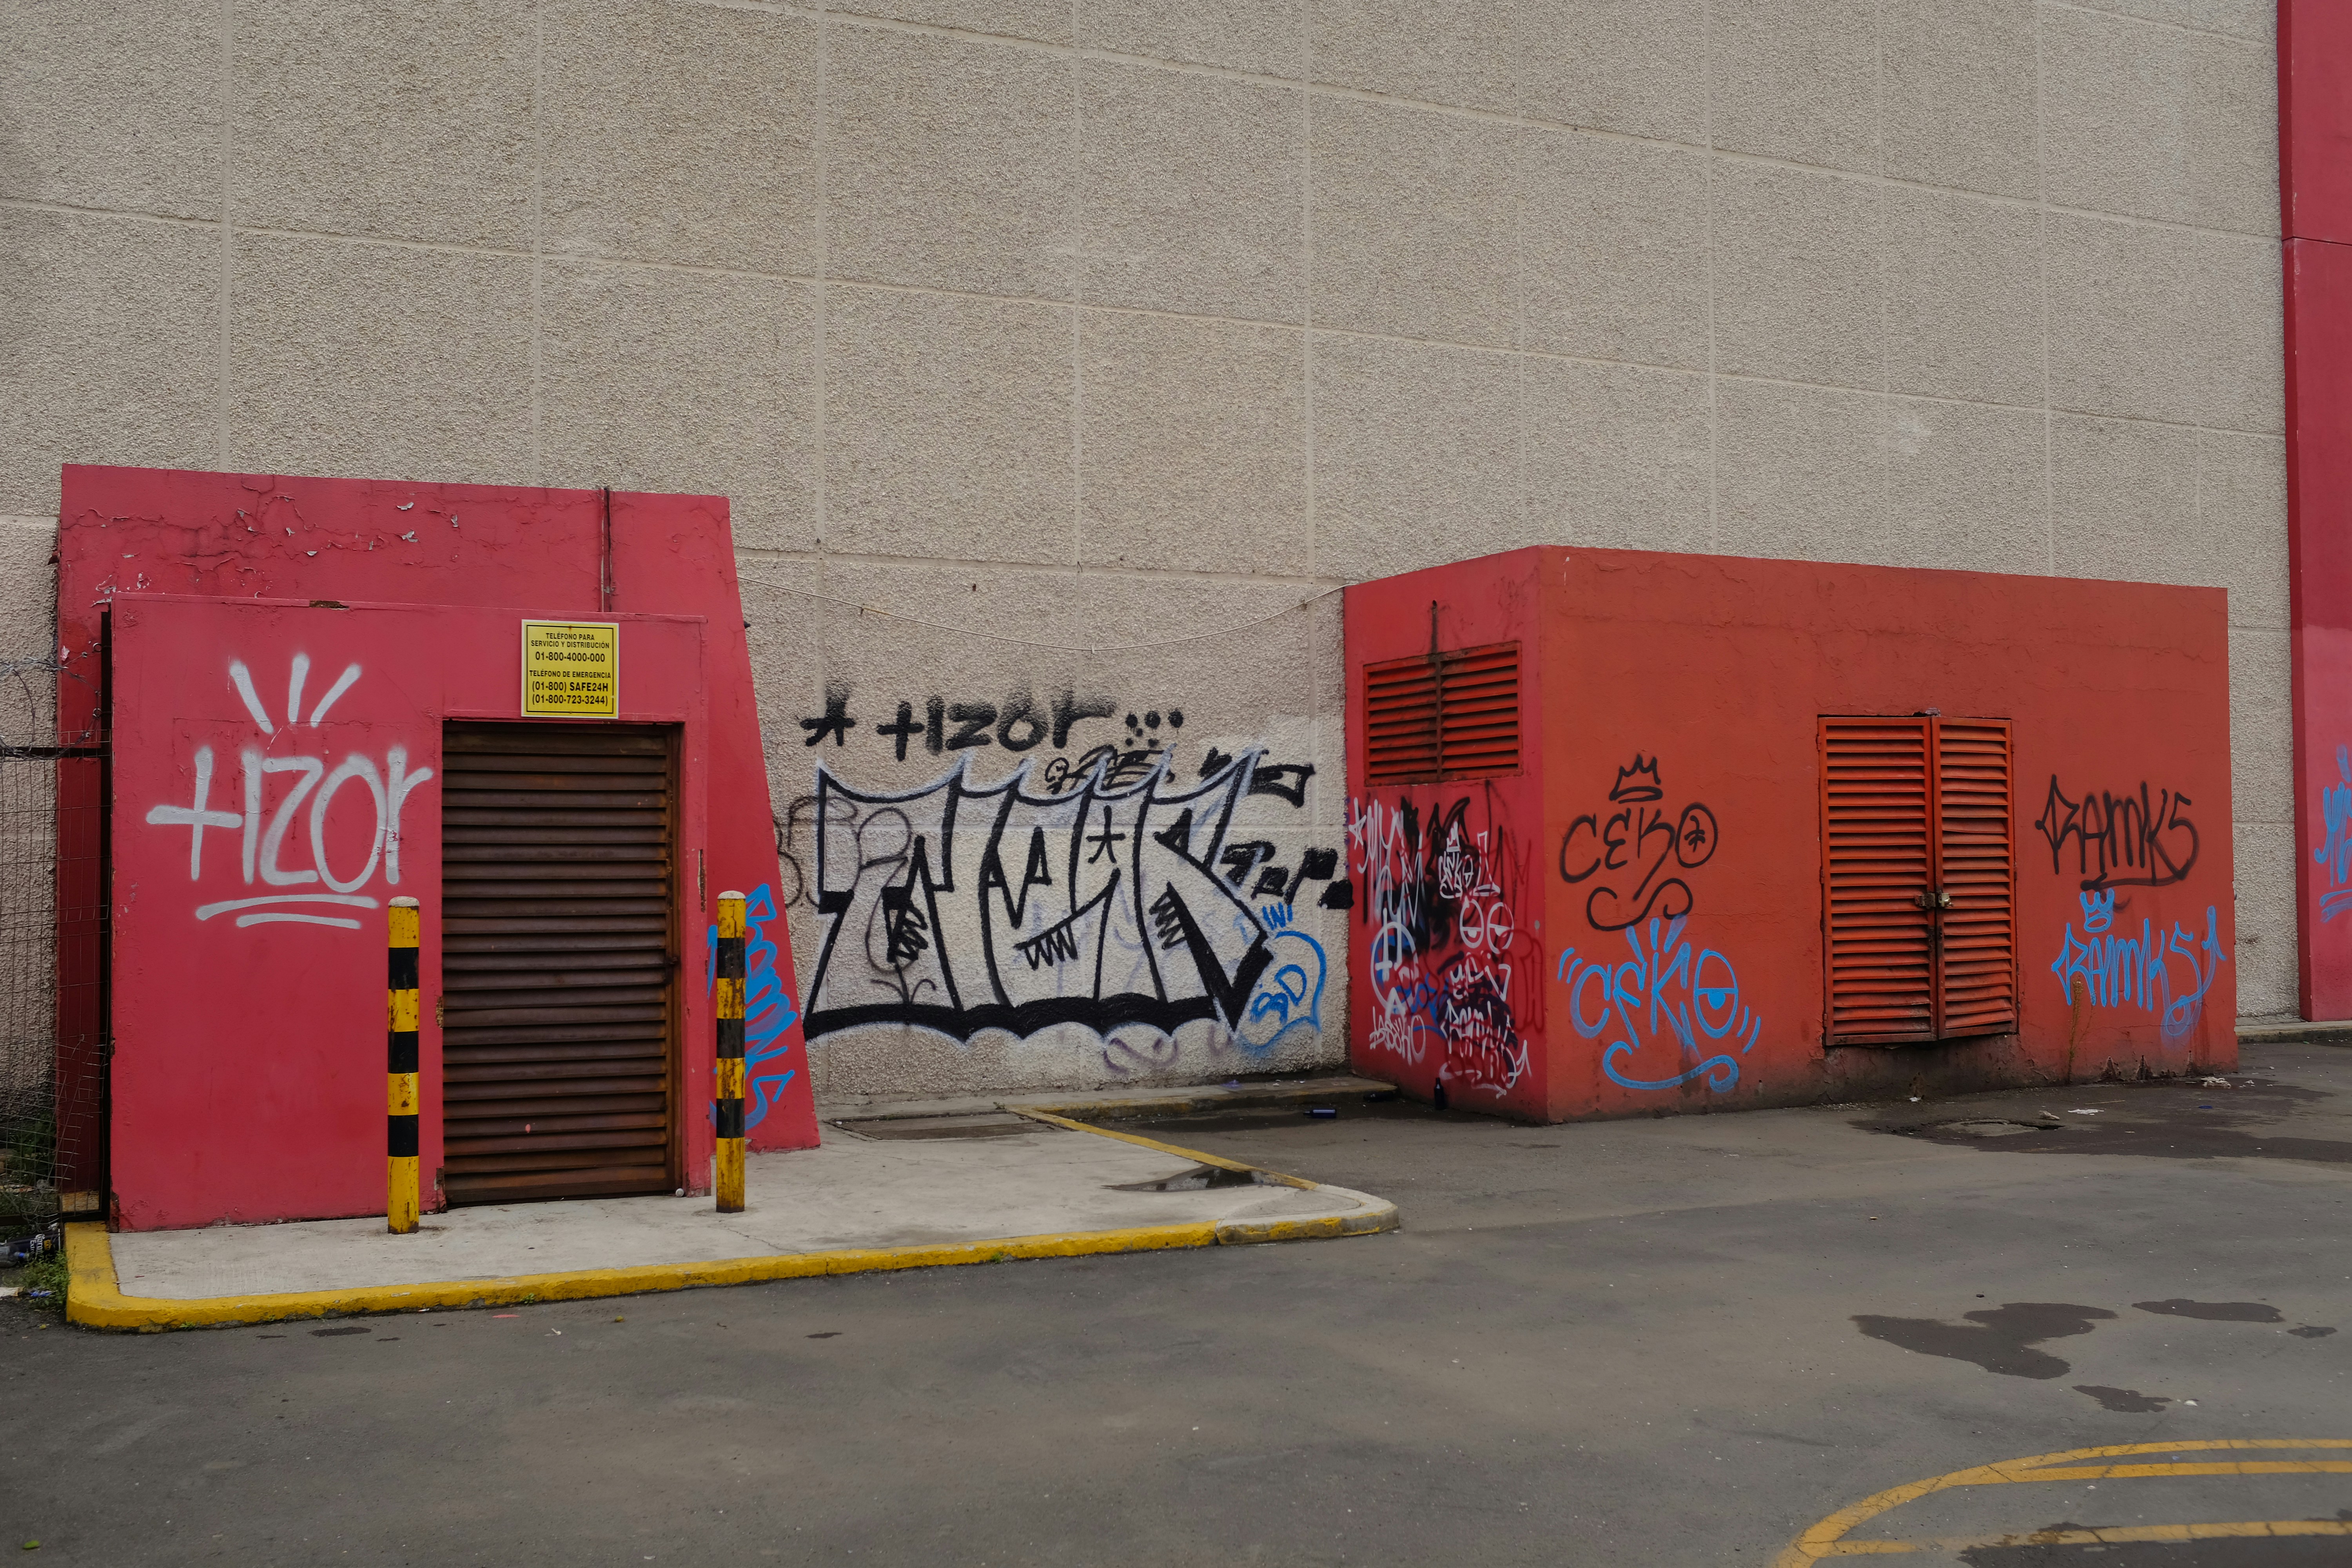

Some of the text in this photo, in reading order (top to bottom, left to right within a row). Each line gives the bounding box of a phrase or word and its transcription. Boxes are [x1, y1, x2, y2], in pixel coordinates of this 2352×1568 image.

[535, 651, 605, 662] 01-800-4000-000
[532, 681, 608, 693] (01-800) SAFE24H
[532, 694, 608, 706] (01-800-723-3244)
